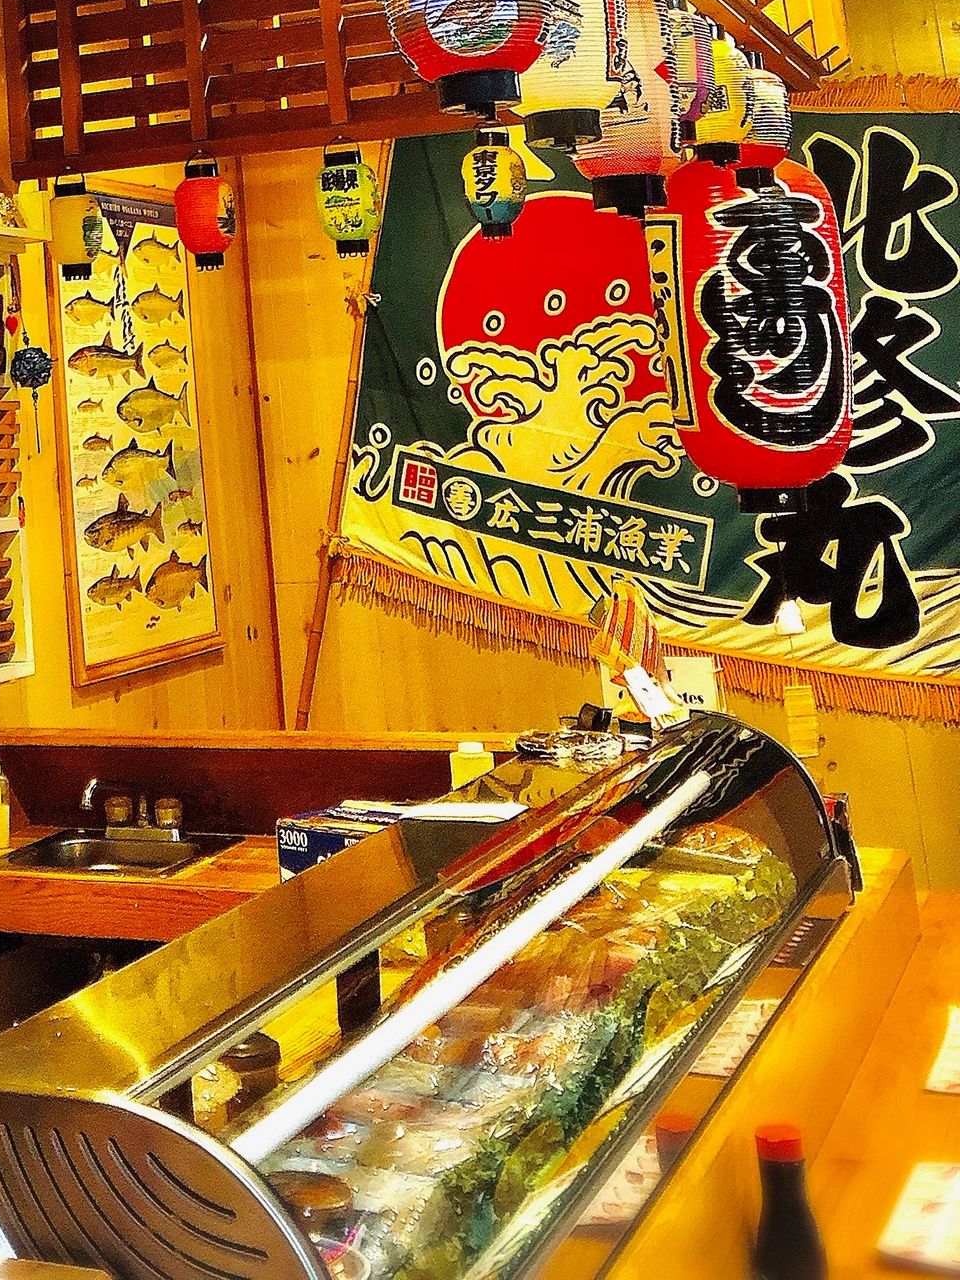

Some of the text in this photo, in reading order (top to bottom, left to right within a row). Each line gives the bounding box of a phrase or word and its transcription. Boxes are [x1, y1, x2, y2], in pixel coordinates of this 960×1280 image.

[472, 150, 498, 221] 東京タワー
[527, 500, 695, 573] 三浦漁業
[279, 829, 308, 848] 3000
